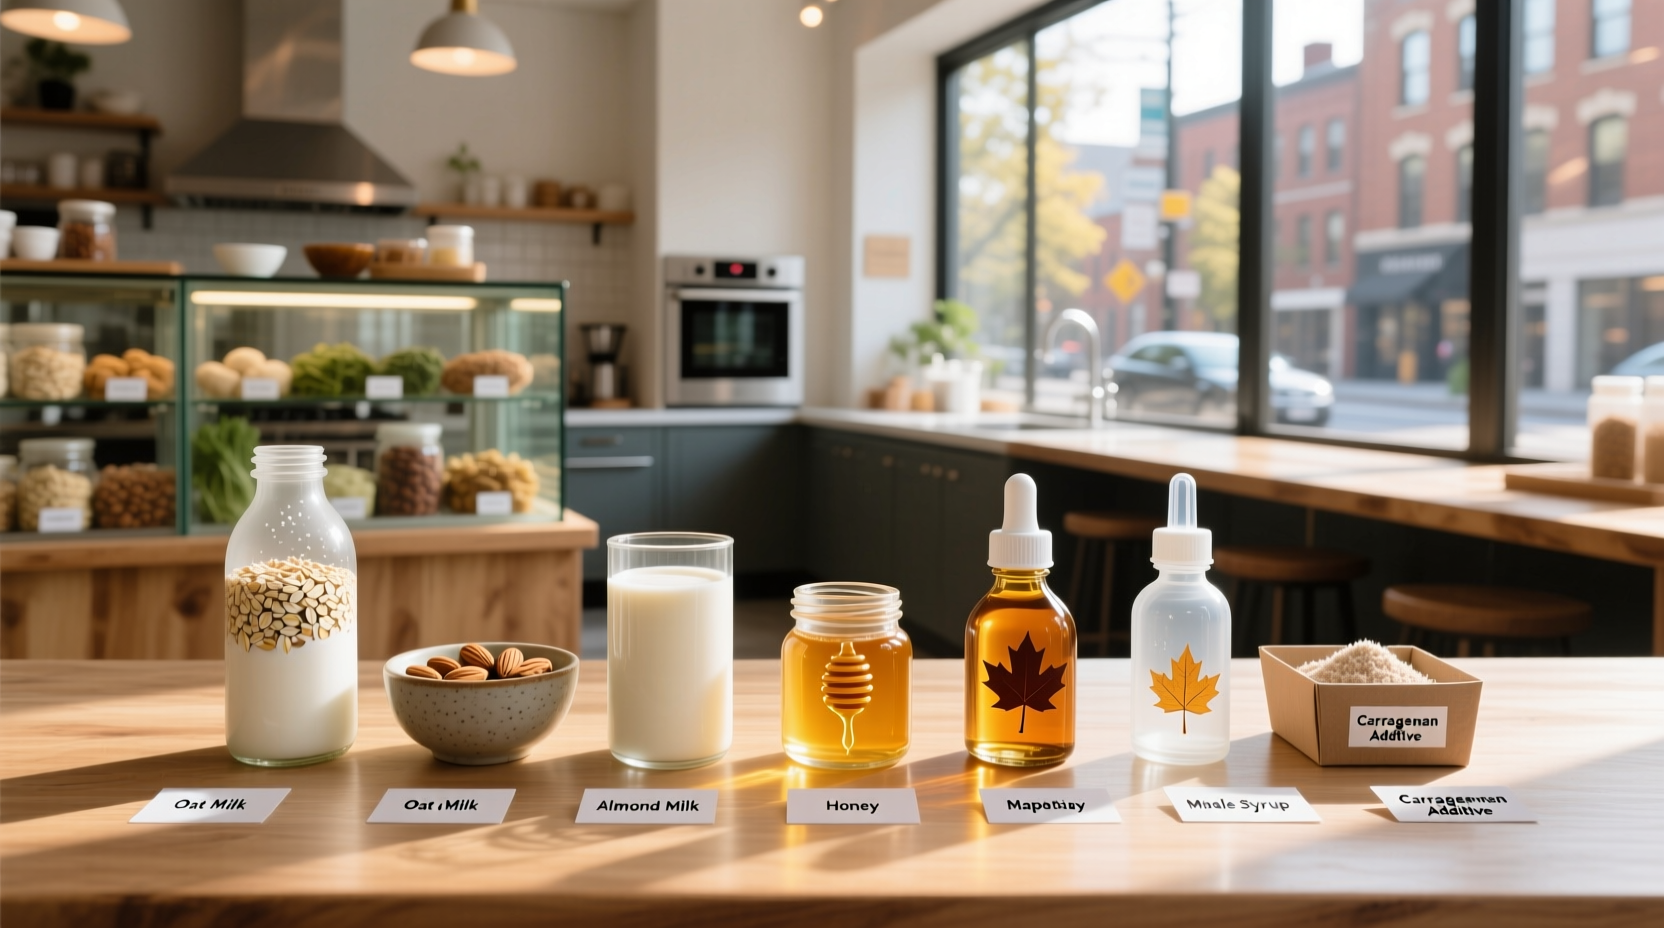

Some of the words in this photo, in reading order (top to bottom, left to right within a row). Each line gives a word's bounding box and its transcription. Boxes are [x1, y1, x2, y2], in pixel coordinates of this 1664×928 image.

[174, 799, 206, 809] Oat
[210, 798, 247, 810] Milk
[596, 799, 661, 812] Almond
[665, 799, 700, 812] Milk
[826, 799, 880, 814] Honey
[1239, 799, 1290, 813] Syrup
